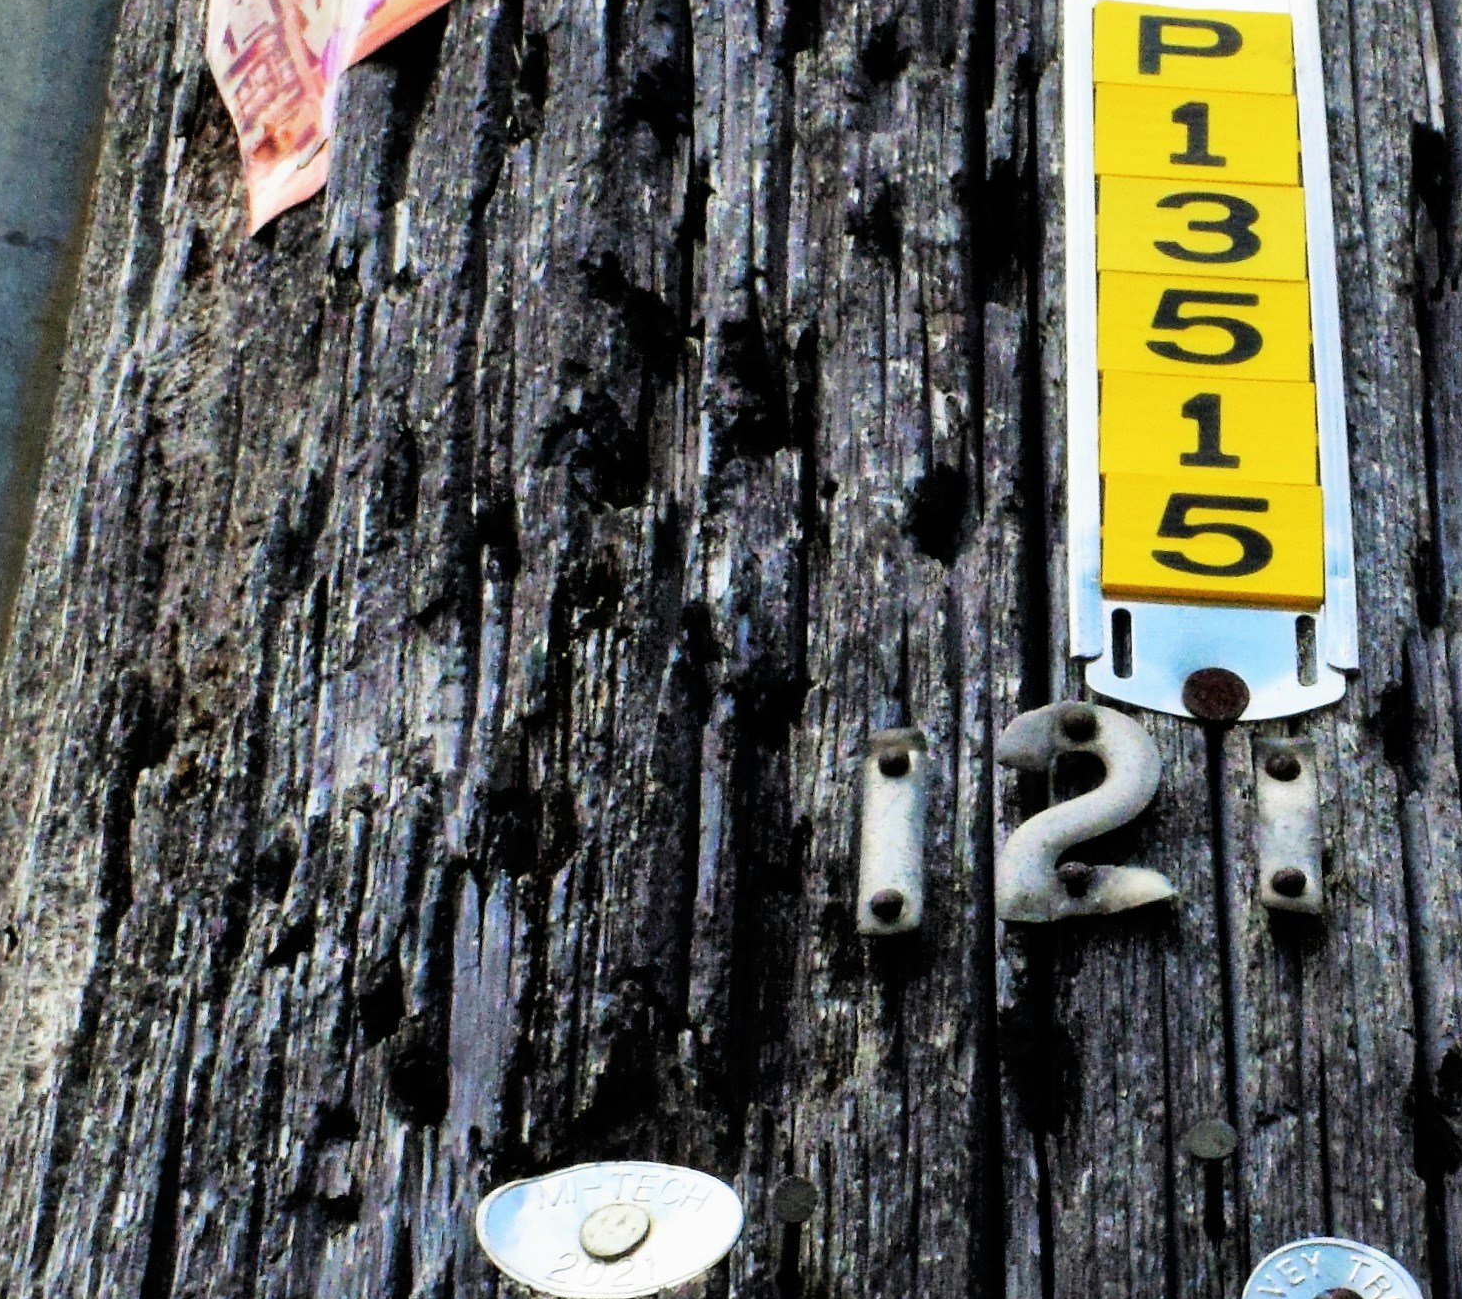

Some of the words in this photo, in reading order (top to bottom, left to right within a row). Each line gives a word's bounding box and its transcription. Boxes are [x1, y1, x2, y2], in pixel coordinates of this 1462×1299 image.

[1136, 13, 1276, 580] P13515
[535, 1172, 715, 1213] MI-TECH
[546, 1251, 657, 1288] 2021
